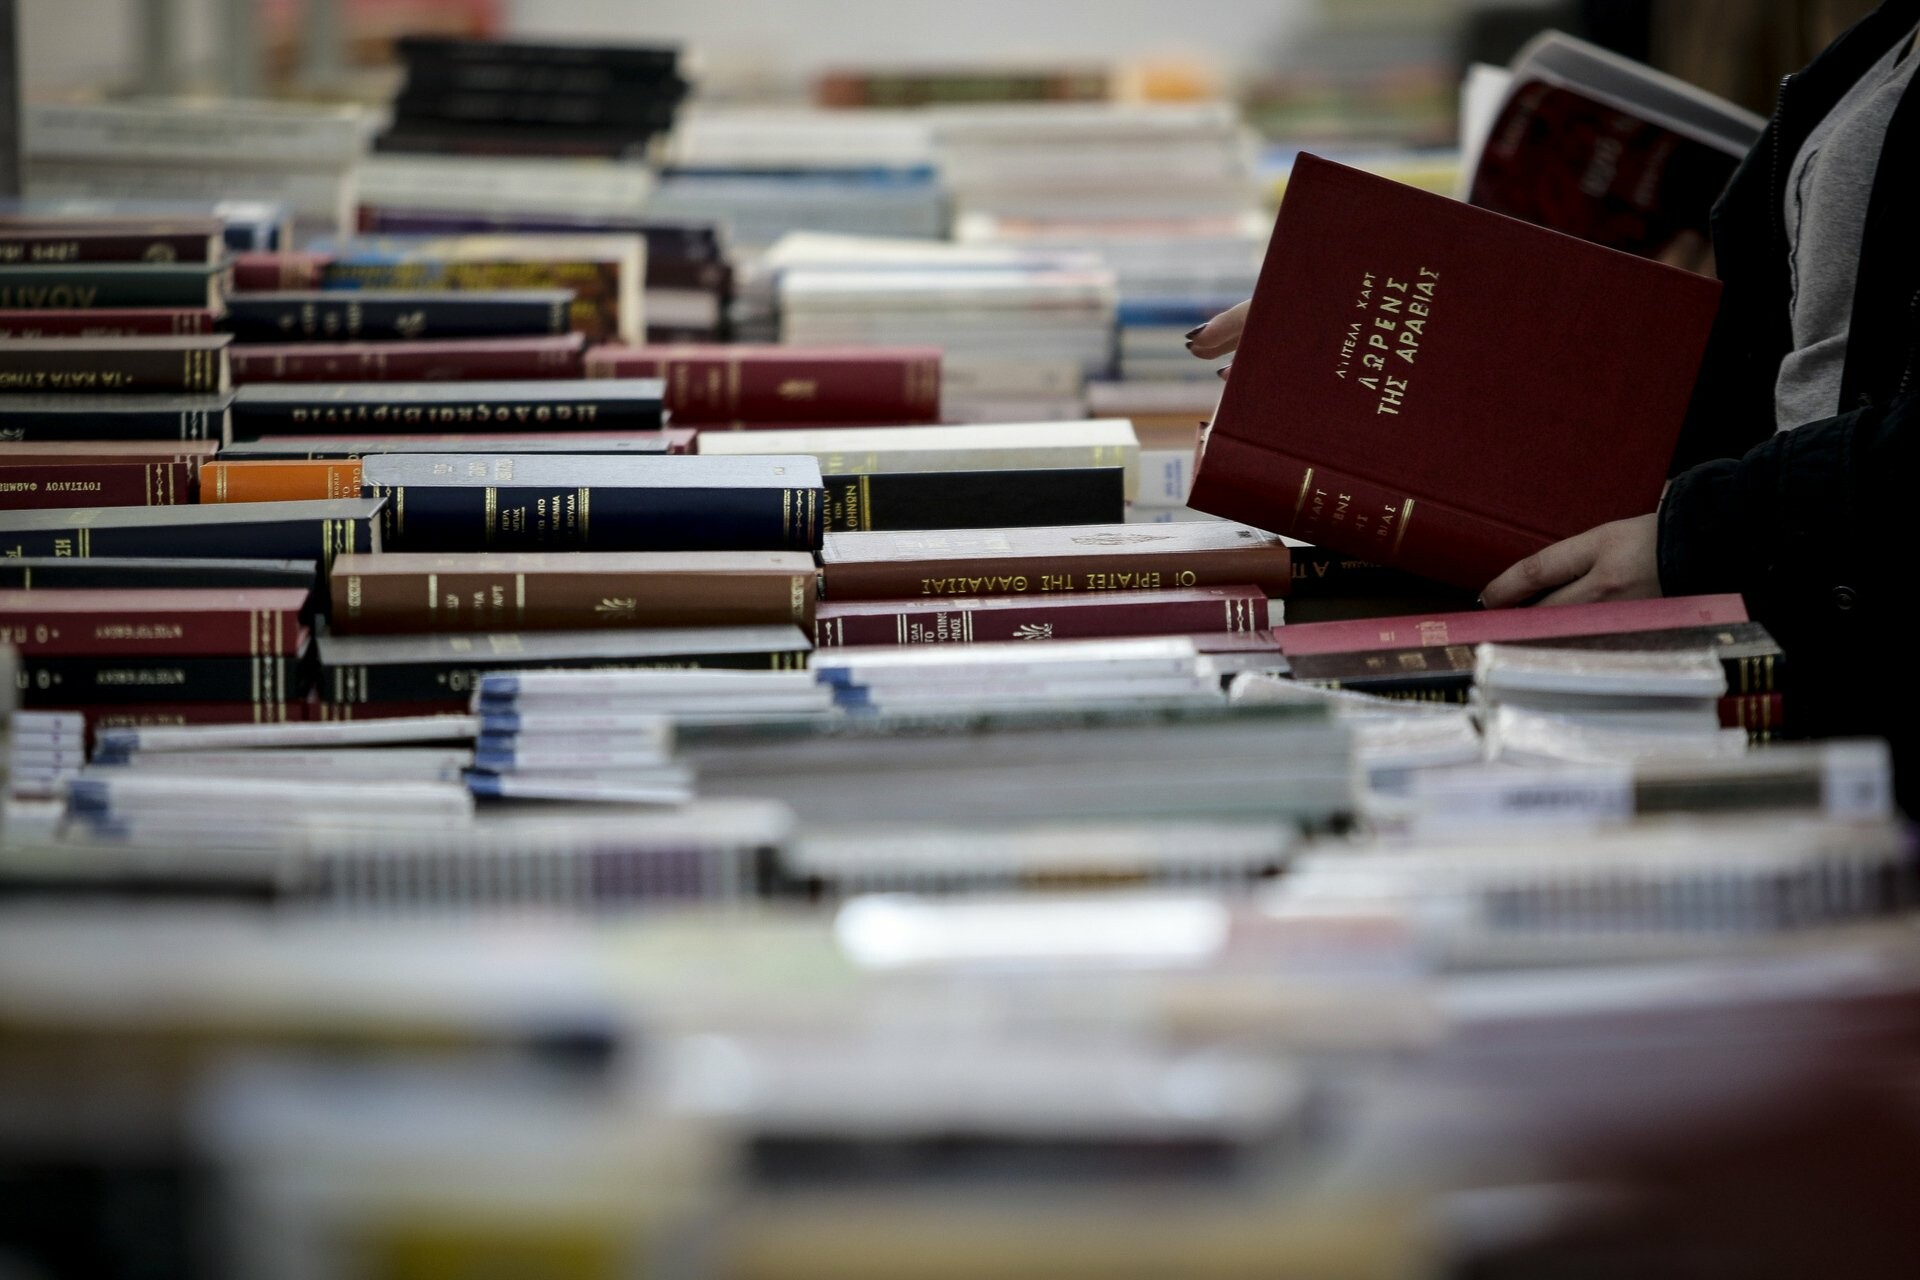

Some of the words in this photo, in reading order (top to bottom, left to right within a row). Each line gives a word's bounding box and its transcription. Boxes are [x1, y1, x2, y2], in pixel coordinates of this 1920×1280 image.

[1357, 273, 1376, 309] ΧΑΡΤ
[1358, 277, 1409, 391] ΛΩΡΕΝΣ
[1377, 375, 1408, 415] ΤΗΣ
[1395, 267, 1440, 364] ΑΡΑΒΙΑΣ
[44, 481, 101, 492] ΓΟΥΣΤΑΥΟΥ
[537, 498, 546, 517] ΑΠΟ
[921, 575, 1029, 594] ΘΑΛΑΣΣΑΣ
[1040, 574, 1075, 591] ΤΗΣ
[1086, 571, 1161, 591] ΕΡΓΑΤΕΣ
